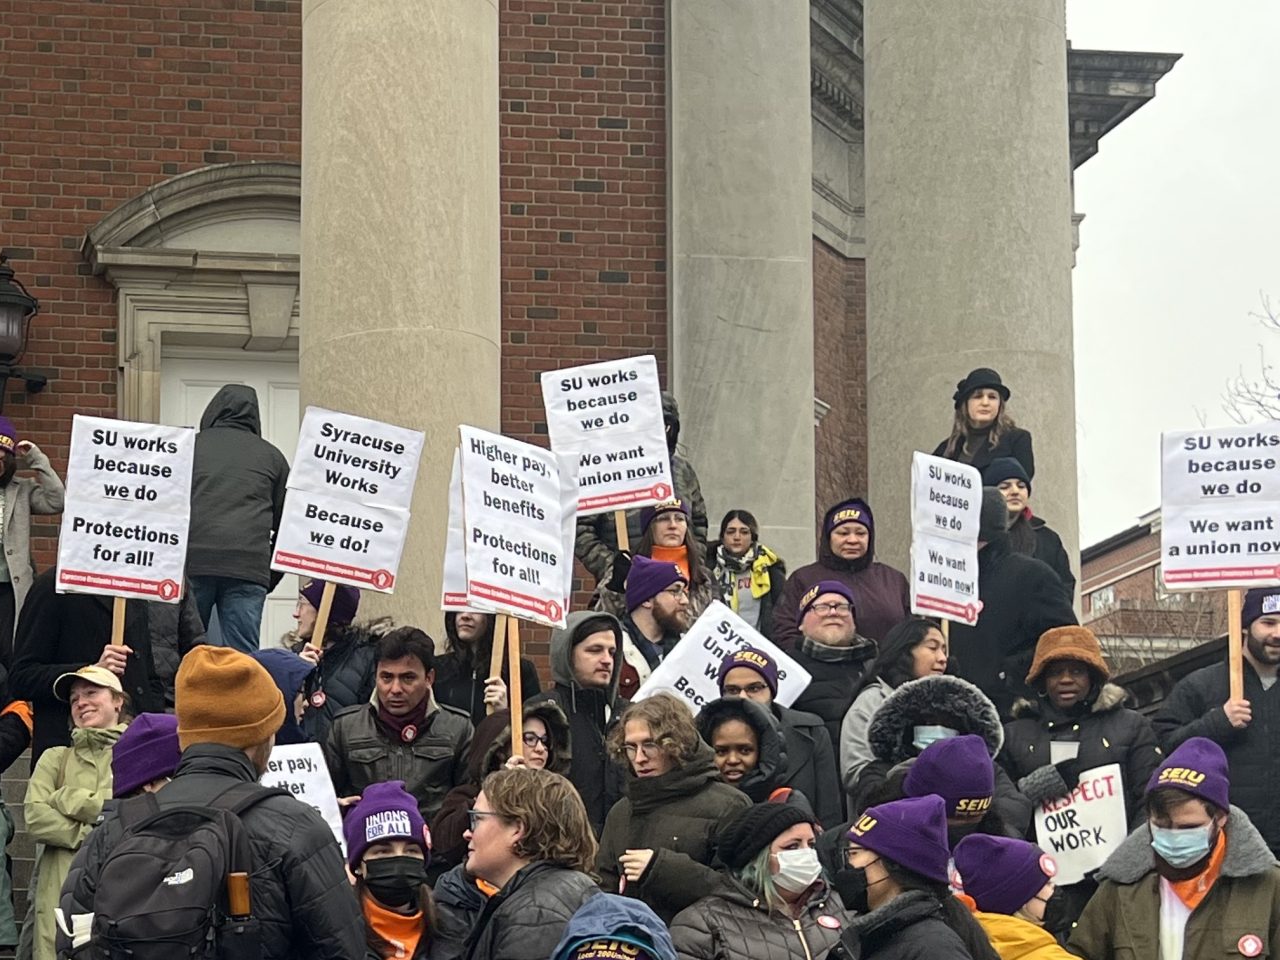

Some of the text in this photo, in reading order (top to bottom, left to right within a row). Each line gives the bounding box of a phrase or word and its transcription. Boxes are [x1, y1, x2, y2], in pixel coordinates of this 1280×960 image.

[561, 370, 638, 392] SU works
[567, 391, 638, 412] because
[581, 412, 630, 430] we do
[92, 429, 178, 454] SU works
[320, 422, 405, 455] Syracuse
[1184, 433, 1280, 451] SU works
[314, 443, 402, 479] University
[471, 438, 551, 479] Higher pay,
[606, 445, 645, 463] want
[93, 454, 173, 478] because
[626, 461, 664, 480] now!
[929, 464, 972, 489] SU works
[1188, 458, 1276, 474] because
[104, 484, 158, 501] we do
[326, 470, 379, 494] Works
[491, 468, 535, 494] better
[1201, 480, 1262, 495] we do
[484, 490, 545, 521] benefits
[929, 487, 969, 511] because
[305, 503, 384, 533] Because
[935, 513, 962, 531] we do
[1189, 517, 1274, 533] We want
[72, 517, 180, 546] Protections
[310, 530, 370, 553] we do!
[92, 544, 154, 567] for all!
[473, 527, 557, 566] Protections
[1169, 545, 1180, 557] a
[1186, 541, 1241, 555] union
[492, 557, 540, 585] for all!
[928, 549, 967, 572] We want
[919, 571, 974, 595] a union now!
[288, 756, 318, 775] pay,
[1159, 767, 1206, 782] SEIU
[956, 796, 992, 811] SEIU
[365, 810, 409, 828] UNIONS
[367, 822, 410, 839] FOR ALL
[1045, 809, 1080, 832] OUR
[1049, 826, 1107, 853] WORK
